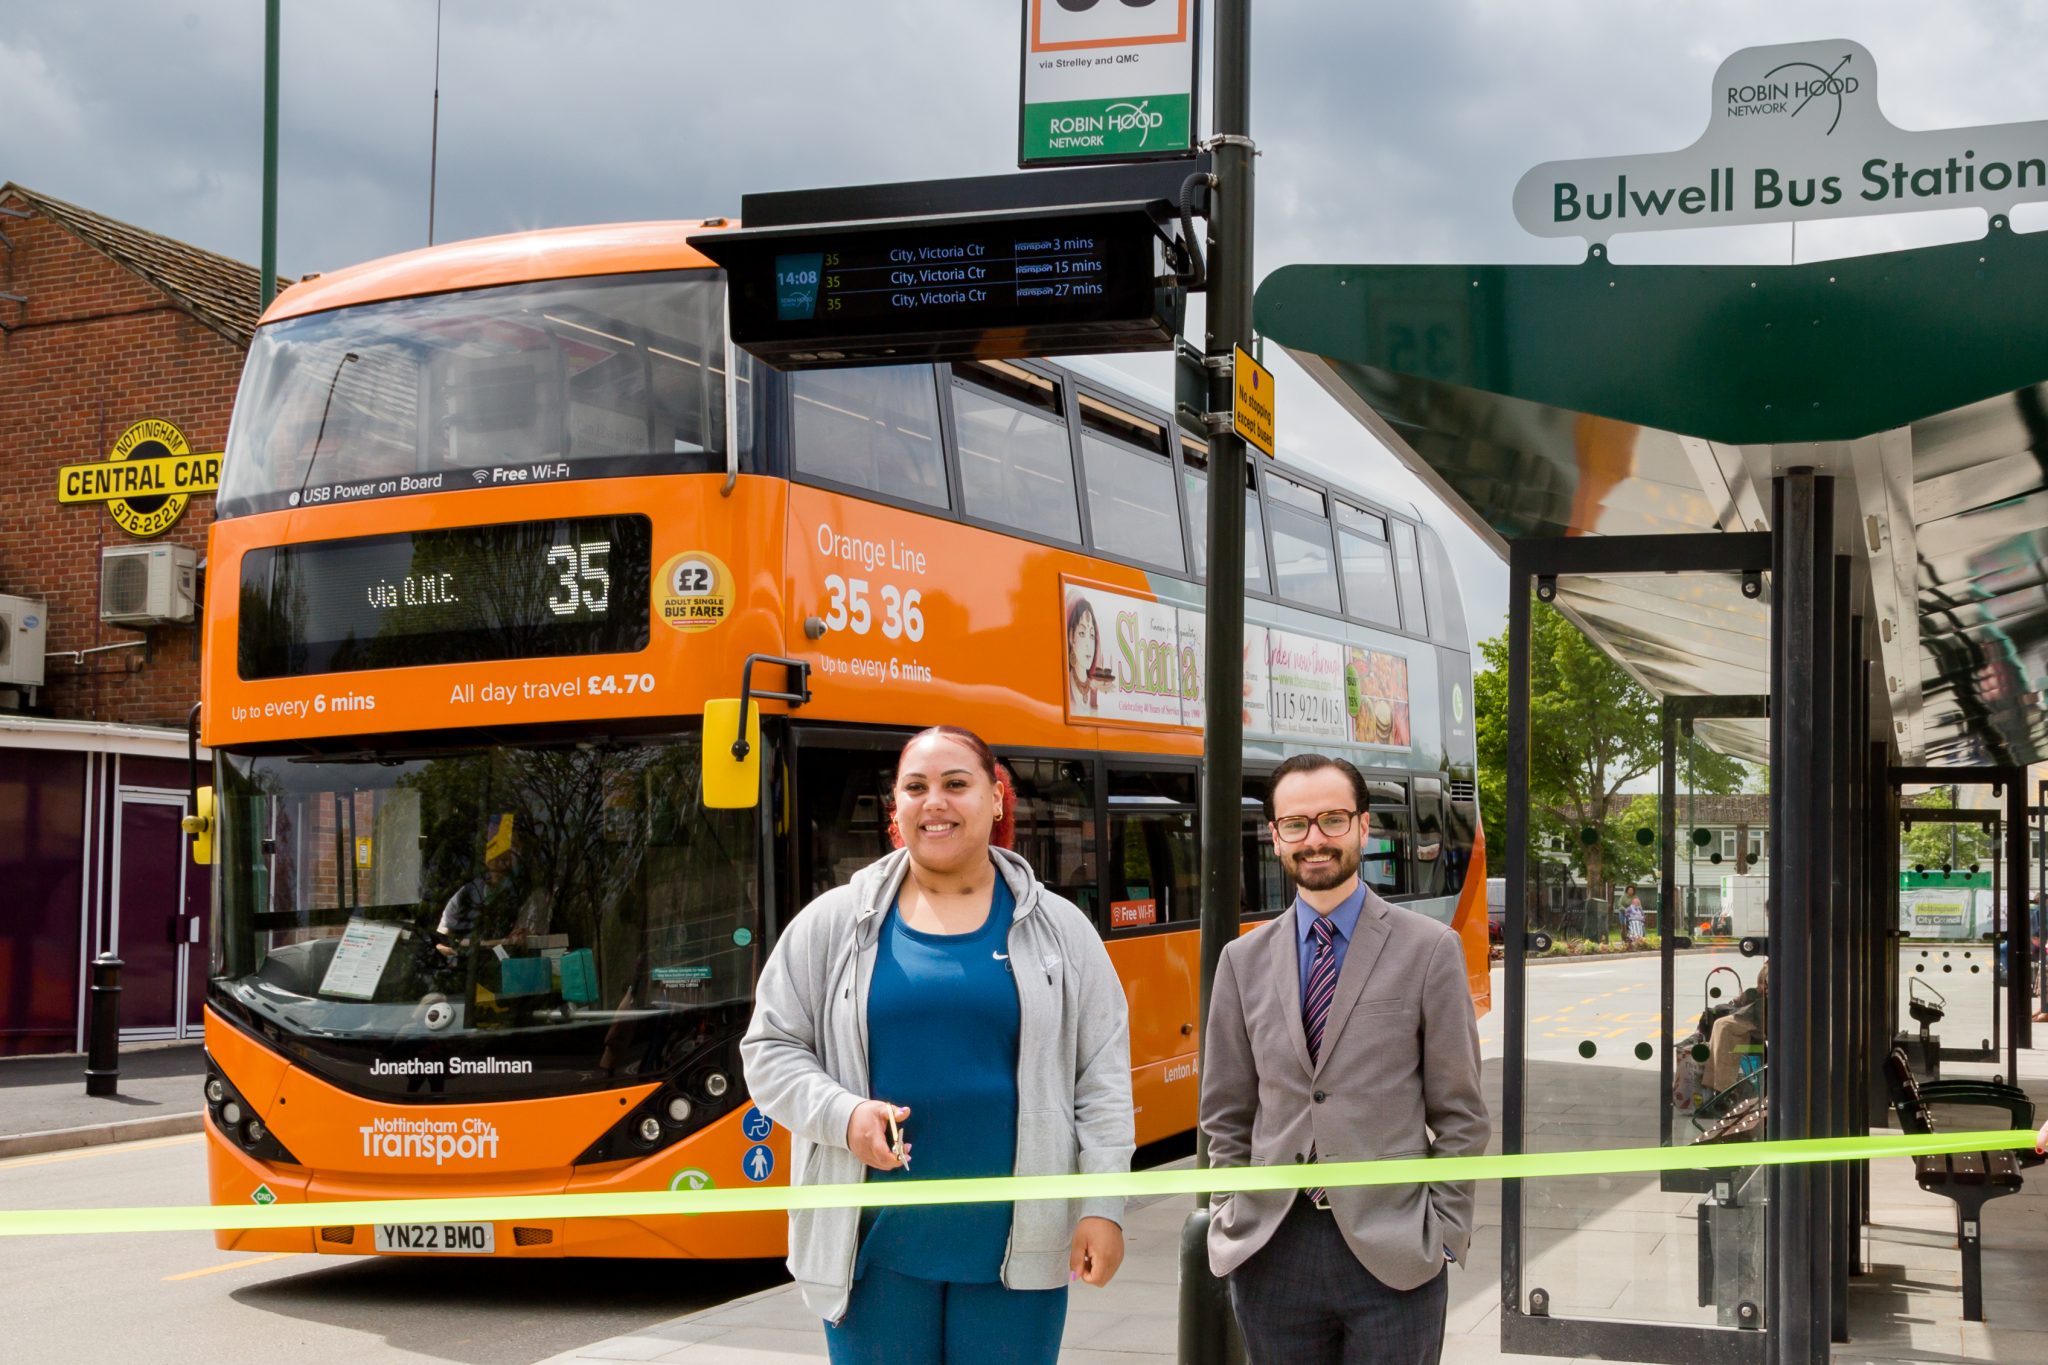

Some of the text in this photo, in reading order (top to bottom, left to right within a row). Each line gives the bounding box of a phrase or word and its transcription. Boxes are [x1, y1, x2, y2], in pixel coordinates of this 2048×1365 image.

[1039, 54, 1139, 69] via Strelley and QMC
[1728, 77, 1859, 104] ROBIN HOOD
[1050, 112, 1163, 134] ROBIN HOOD
[1728, 102, 1787, 117] NETWORK
[1050, 135, 1104, 149] NETWORK
[1554, 150, 2047, 222] Bulwell Bus Station
[825, 254, 840, 266] 35
[890, 249, 917, 264] City,
[918, 245, 964, 260] Victoria
[966, 244, 985, 257] Ctr
[1053, 238, 1061, 250] 3
[1064, 237, 1094, 249] mins
[777, 271, 817, 286] 14:08
[826, 276, 841, 288] 35
[890, 271, 917, 286] City,
[919, 268, 965, 282] Victoria
[967, 266, 986, 279] Ctr
[1055, 262, 1069, 273] 15
[1072, 260, 1102, 272] mins
[827, 299, 842, 311] 35
[892, 294, 918, 309] City,
[920, 291, 966, 305] Victoria
[968, 289, 987, 302] Ctr
[1055, 284, 1070, 296] 27
[1073, 282, 1103, 295] mins
[1239, 384, 1271, 426] No stopping
[116, 422, 183, 456] NOTTINGHAM
[1237, 411, 1272, 446] except buses
[67, 458, 223, 496] CENTRAL CAR
[303, 464, 570, 503] USB Power on Board Free Wi-Fi
[113, 498, 182, 533] 976-2222
[818, 523, 926, 574] Orange Line
[547, 541, 611, 615] 35
[679, 569, 708, 591] £2
[368, 579, 397, 608] via
[665, 606, 724, 617] BUS FARES
[824, 574, 925, 643] 35 36
[821, 655, 932, 683] Up to every 6 mins
[1115, 610, 1199, 701] Shama
[450, 673, 655, 705] All day travel £4.70
[231, 691, 376, 722] Up to every 6 mins
[1300, 694, 1318, 722] 922
[1121, 904, 1155, 921] Free Wi-Fi
[370, 1057, 532, 1075] Jonathan Smallman
[1164, 1062, 1190, 1083] Lenton
[374, 1117, 491, 1135] Nottingham City
[359, 1126, 499, 1165] Transport
[383, 1225, 485, 1249] YN22 BMO
